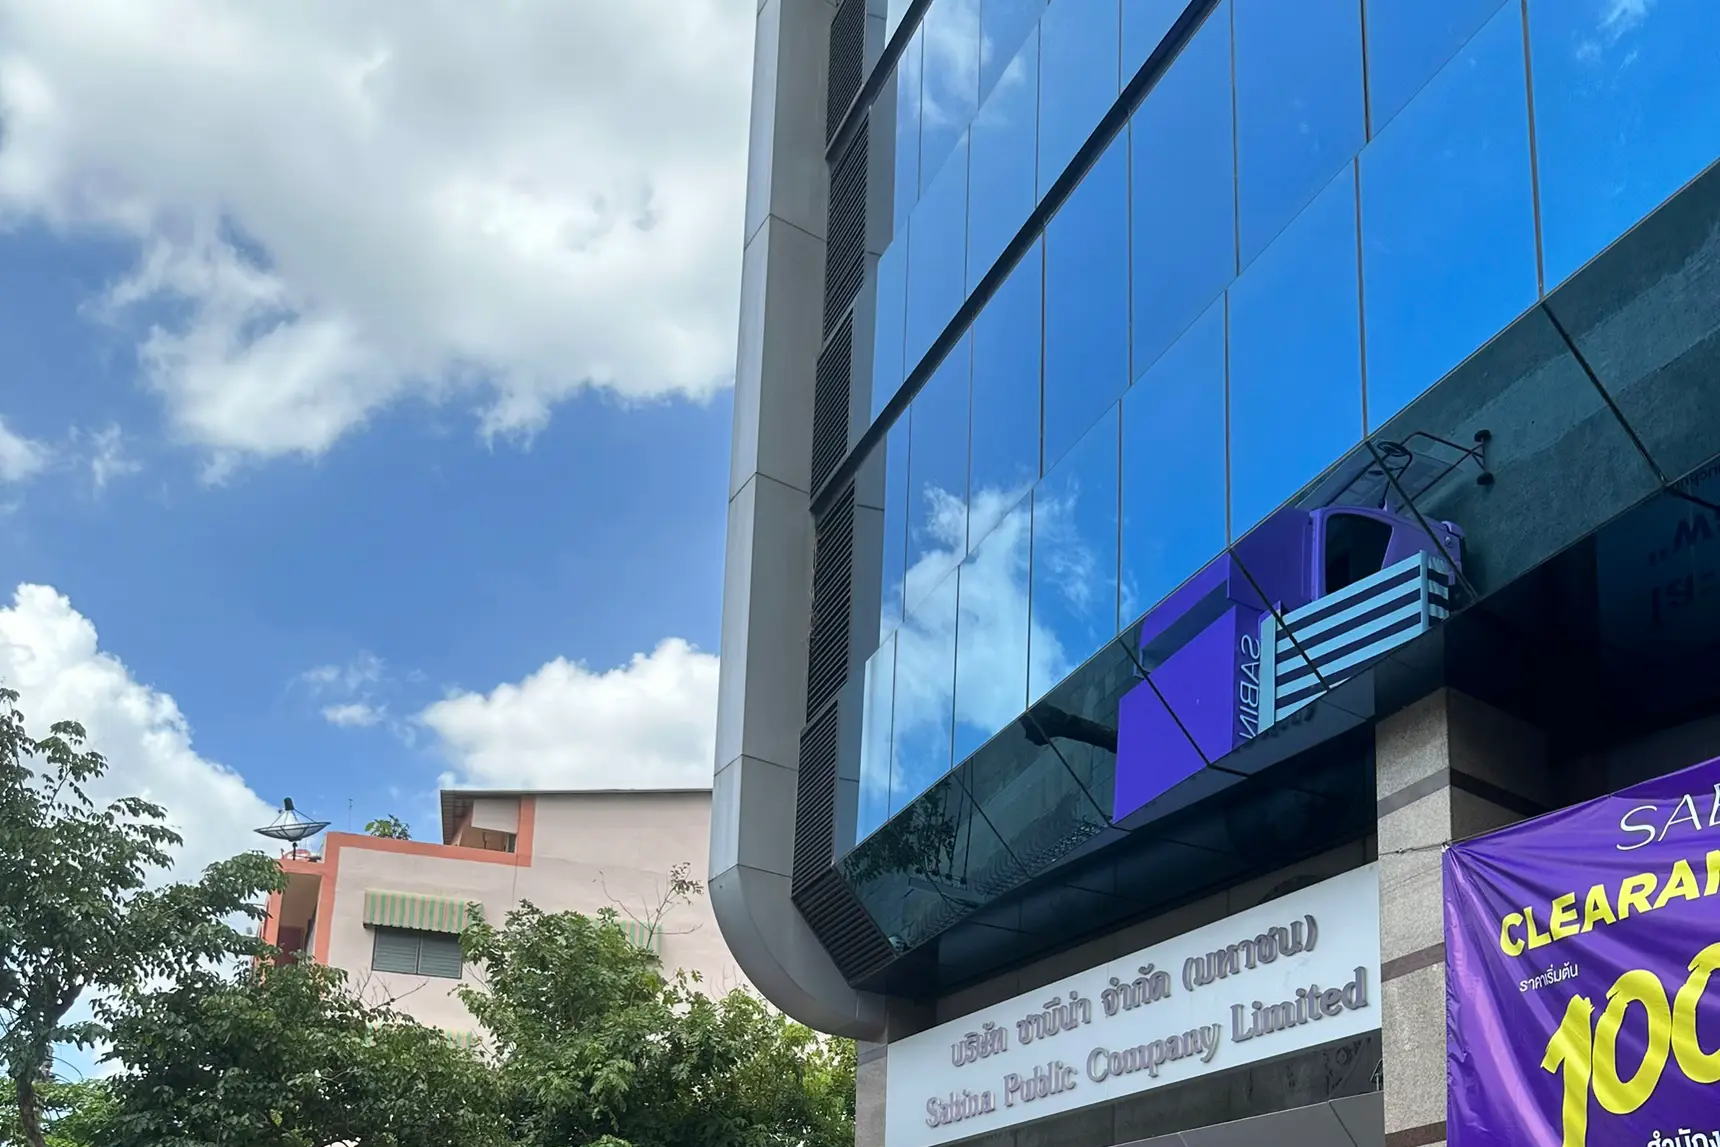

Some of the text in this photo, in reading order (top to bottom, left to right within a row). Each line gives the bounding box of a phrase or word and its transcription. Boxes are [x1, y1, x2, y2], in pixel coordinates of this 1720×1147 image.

[925, 965, 1370, 1128] Sabina Public Company Limited
[951, 1021, 1008, 1067] บริษัท
[1101, 963, 1171, 1017] จำกัด
[1182, 914, 1318, 991] (มหาชน)
[1519, 961, 1579, 992] ราคาเริ่มต้น
